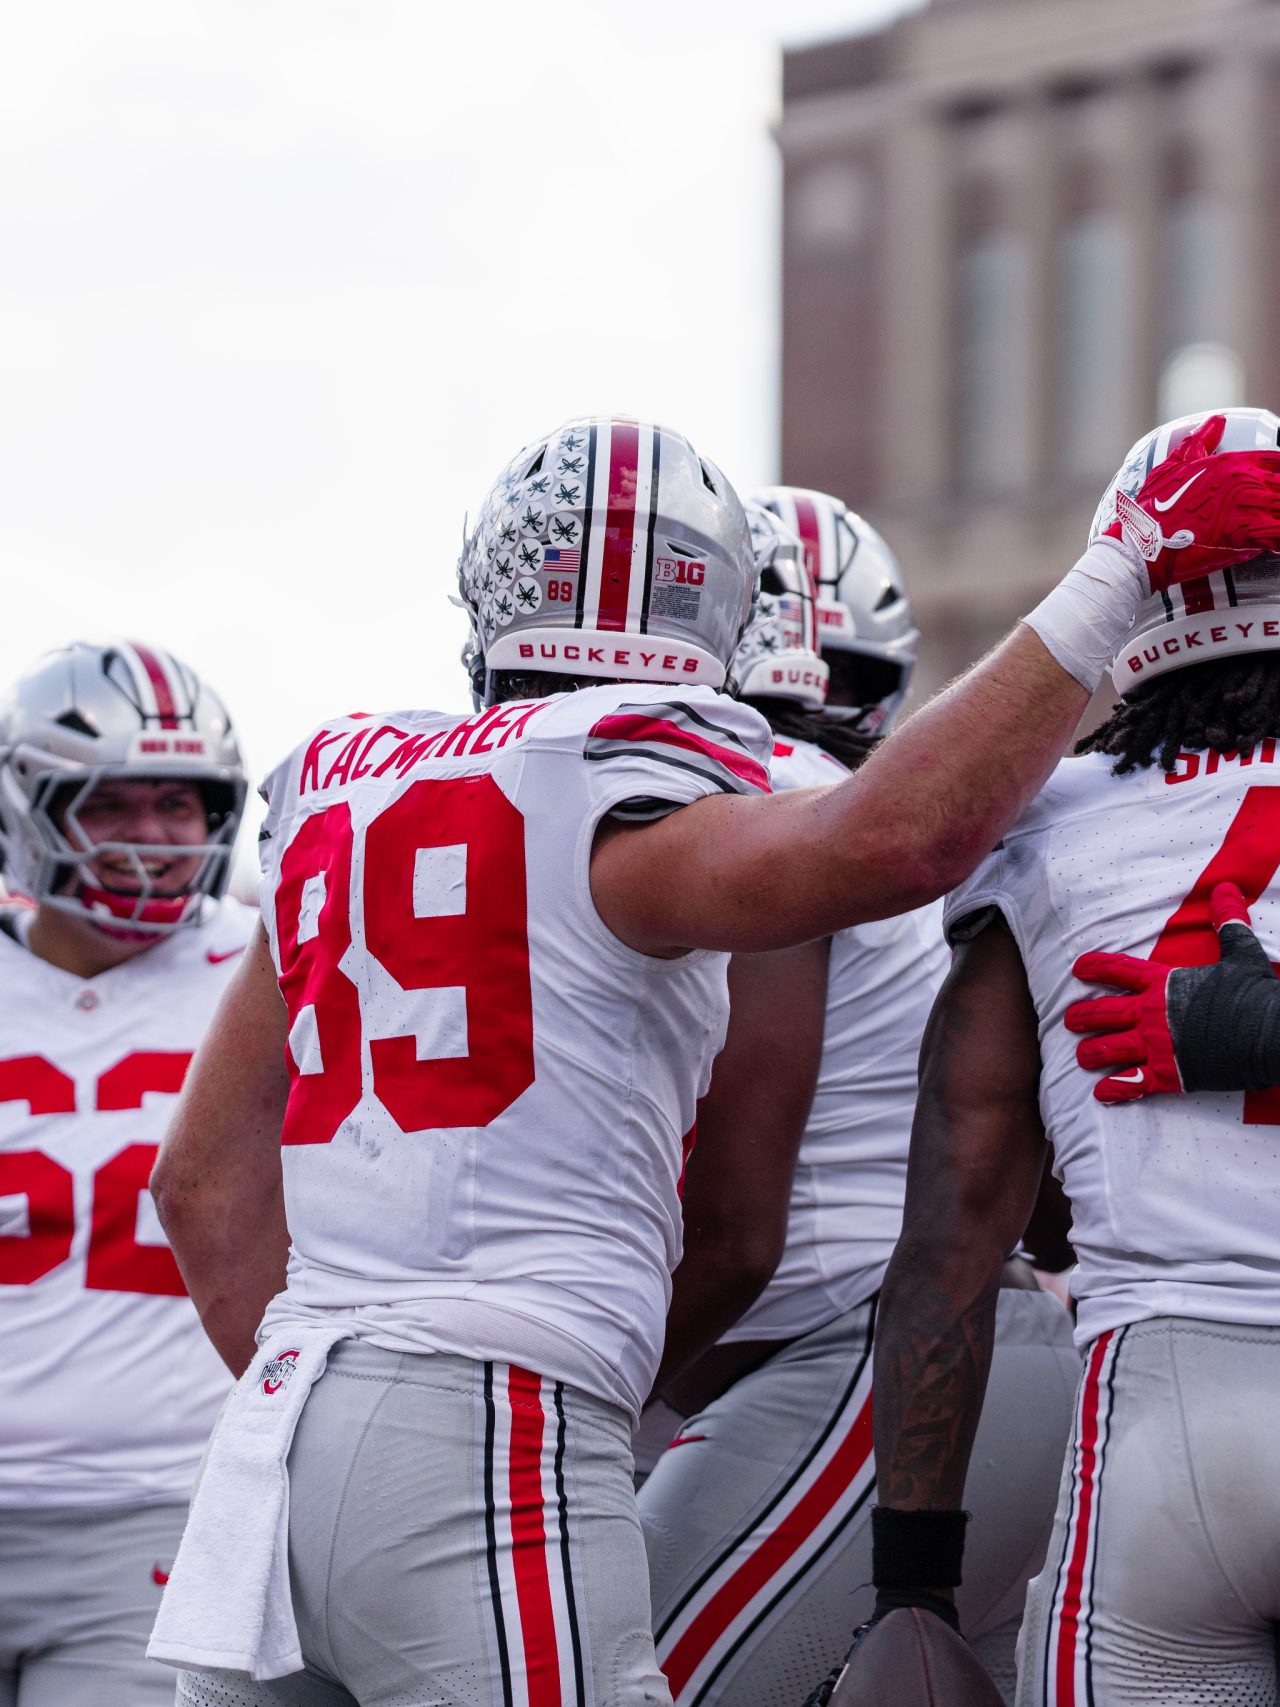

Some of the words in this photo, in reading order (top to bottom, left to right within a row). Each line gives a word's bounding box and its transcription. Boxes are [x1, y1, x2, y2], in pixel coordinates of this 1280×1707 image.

[547, 579, 573, 603] 89
[518, 643, 700, 673] BUCKEYES
[772, 669, 829, 695] BUCK
[275, 774, 536, 1146] 89
